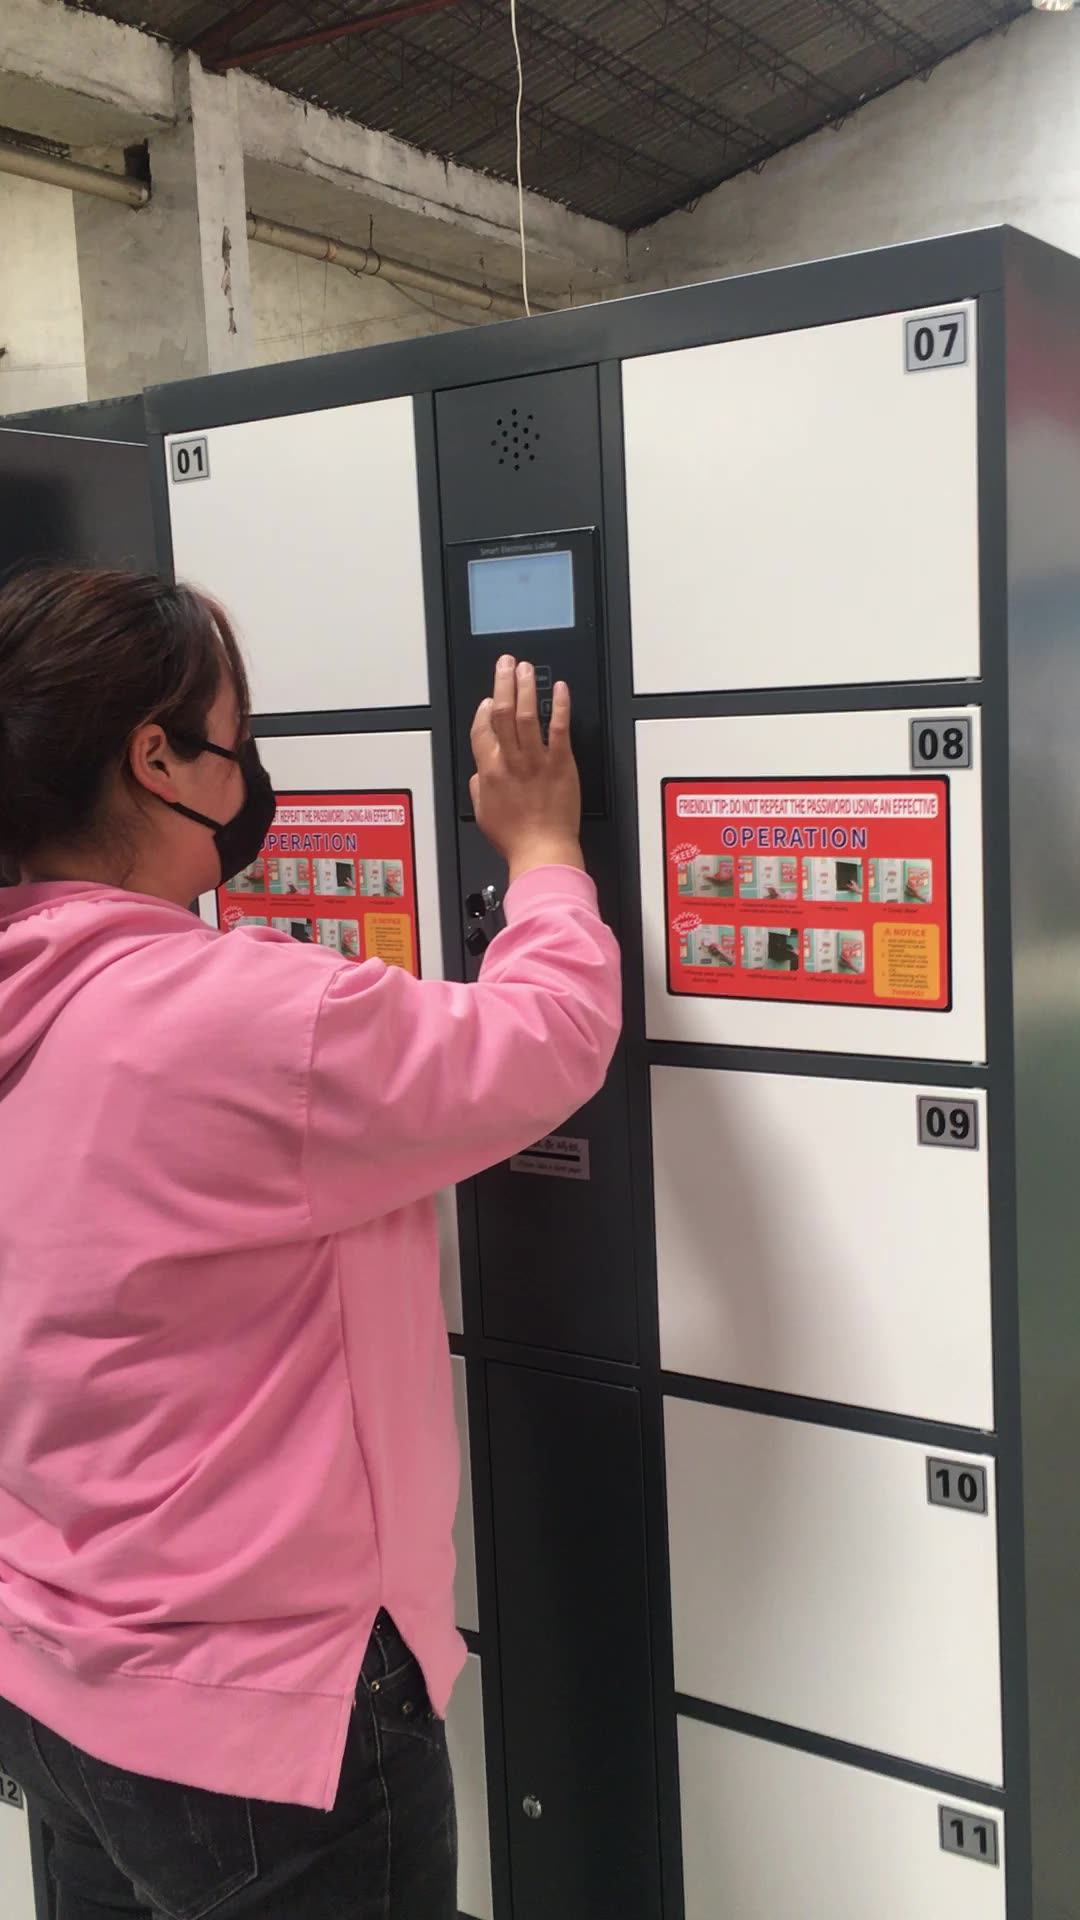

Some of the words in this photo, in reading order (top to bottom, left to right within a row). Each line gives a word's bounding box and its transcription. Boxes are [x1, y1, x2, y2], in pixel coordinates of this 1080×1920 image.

[914, 322, 958, 361] 07
[177, 446, 203, 474] 01
[919, 727, 963, 760] 08
[280, 809, 300, 823] REPEAT
[301, 809, 313, 823] THE
[314, 809, 344, 823] PASSWORD
[679, 798, 713, 815] FRIENDLY
[730, 798, 740, 815] DO
[742, 798, 759, 815] NOT
[760, 798, 788, 815] REPEAT
[789, 798, 806, 815] THE
[807, 798, 851, 815] PASSWORD
[852, 798, 878, 815] USING
[879, 798, 891, 815] AN
[892, 798, 936, 815] EFFECTIVE
[722, 826, 868, 849] OPERATION
[926, 1106, 969, 1140] 09
[935, 1468, 977, 1503] 10
[950, 1819, 987, 1856] 11
